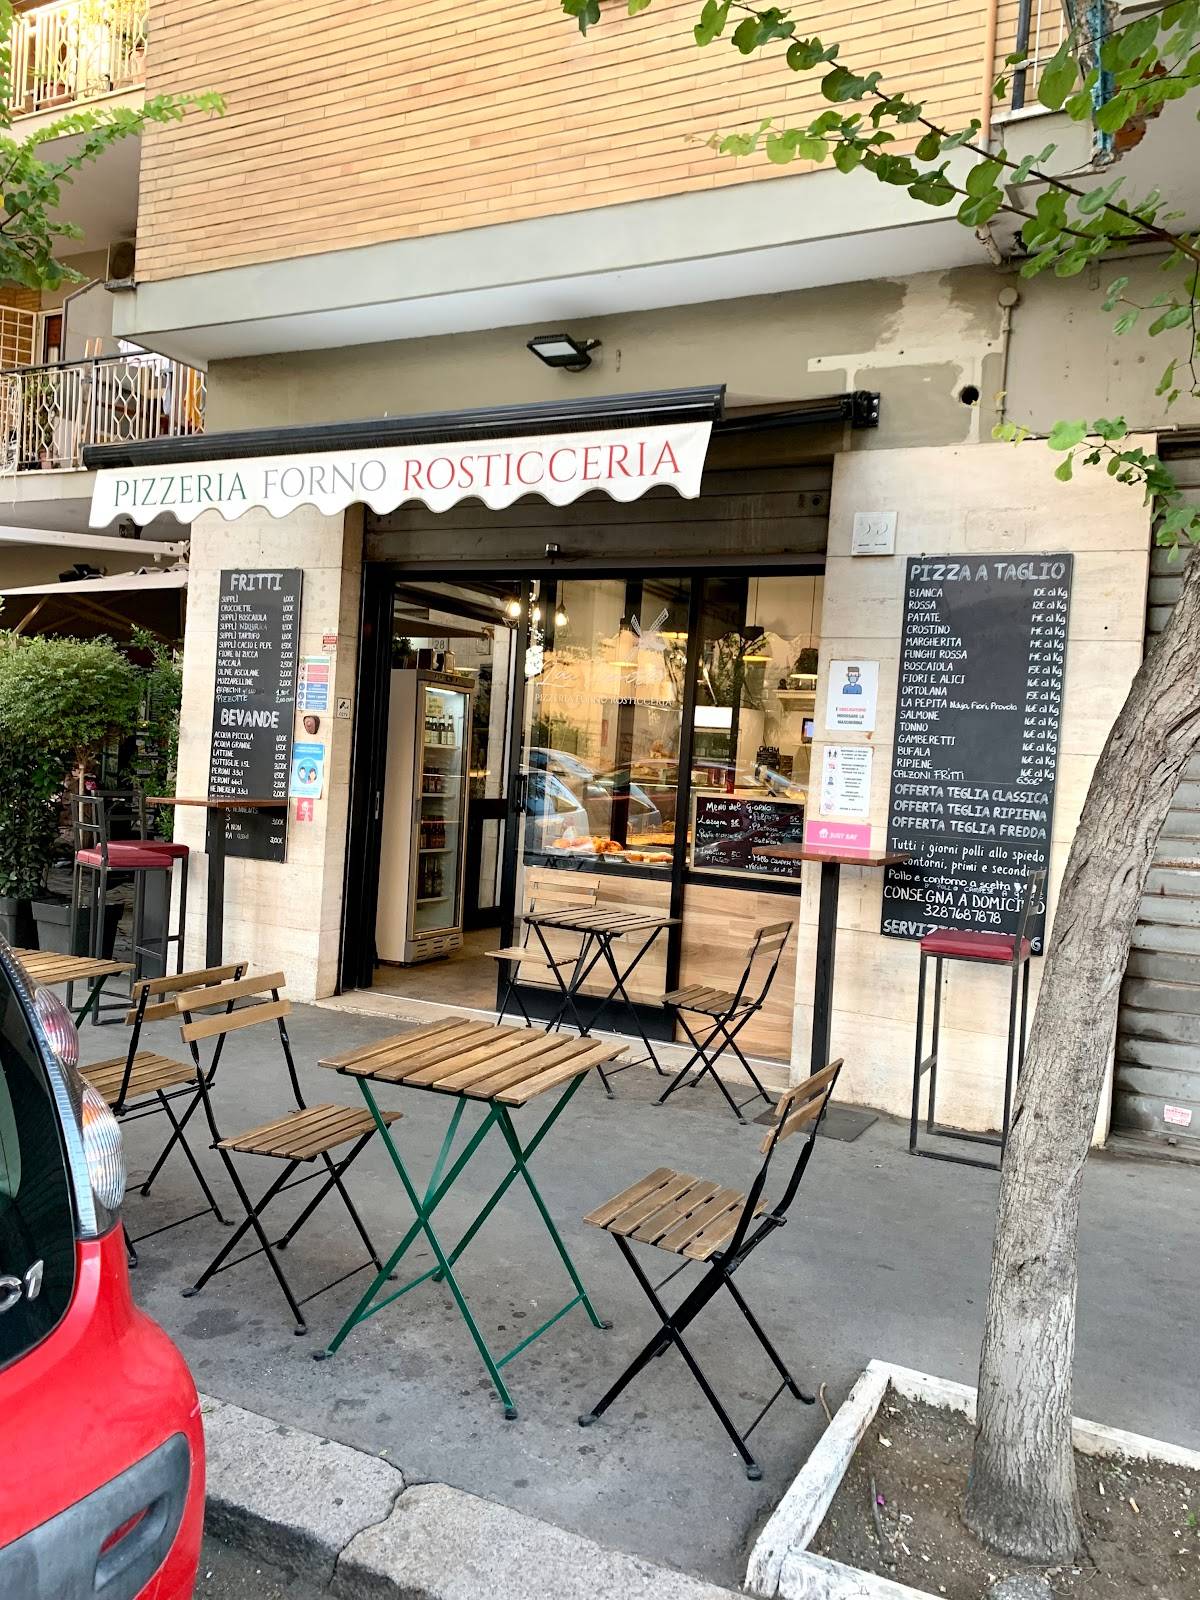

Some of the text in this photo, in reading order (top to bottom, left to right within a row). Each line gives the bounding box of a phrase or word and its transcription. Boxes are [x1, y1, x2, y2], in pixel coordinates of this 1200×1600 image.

[114, 440, 681, 507] PIZZERIA FORNO ROSTICCERIA
[911, 562, 1065, 581] PIZZA A TAGLIO
[231, 574, 283, 591] FRITTI
[910, 588, 943, 597] BIANCA
[909, 601, 936, 609] ROSSA
[908, 613, 940, 622] PATATE
[907, 625, 950, 634] CROSTINO
[906, 638, 962, 646] MARGHERITA
[905, 650, 936, 658] FUNGHI
[940, 650, 967, 659] ROSSA
[904, 662, 953, 671] BOSCAIOLA
[903, 674, 927, 683] FIORI
[931, 675, 935, 683] E
[940, 675, 965, 684] ALICI
[902, 686, 947, 695] ORTOLANA
[901, 699, 912, 707] LA
[915, 699, 947, 708] PEPITA
[991, 702, 1017, 710] Provola
[221, 708, 279, 728] BEVANDE
[900, 711, 939, 720] SALMONE
[899, 722, 928, 731] TONNO
[214, 731, 231, 739] ACQUA
[899, 735, 955, 745] GAMBERETTI
[897, 746, 930, 756] BUFALA
[897, 759, 933, 768] RIPIENE
[893, 769, 964, 780] CALZONI FRITTI
[895, 783, 1048, 804] OFFERTA TEGLIA CLASSICA
[894, 800, 1047, 822] OFFERTA TEGLIA RIPIENA
[892, 817, 1046, 839] OFFERTA TEGLIA FREDDA
[892, 838, 1044, 865] Tutti i giorni polli allo spiedo
[951, 861, 977, 874] primi
[982, 864, 987, 872] e
[992, 864, 1030, 877] secondi
[889, 869, 912, 880] Pollo
[923, 876, 967, 887] contorno
[981, 881, 1010, 891] scelta
[884, 886, 1045, 914] CONSEGNA A DOMICIO
[923, 904, 1001, 924] 3287687878
